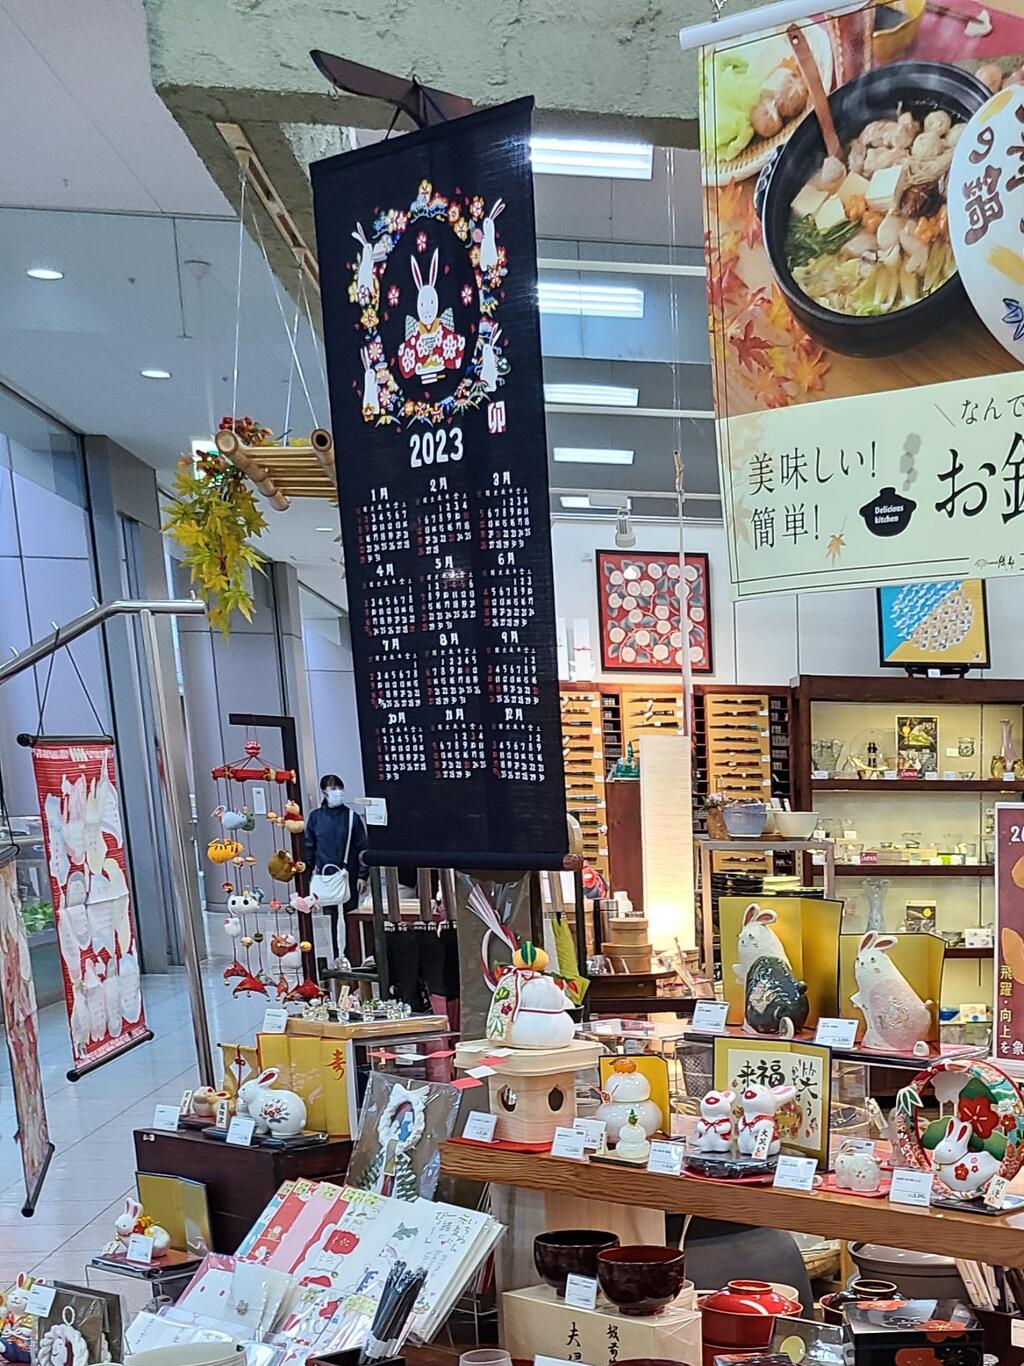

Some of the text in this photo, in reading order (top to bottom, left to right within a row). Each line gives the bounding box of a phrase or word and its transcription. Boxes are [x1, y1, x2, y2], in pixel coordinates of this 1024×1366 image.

[409, 427, 464, 468] 2023
[749, 441, 877, 496] 美味しい！
[430, 477, 448, 492] 2月
[492, 471, 511, 486] 3月
[371, 487, 388, 501] 1月
[874, 504, 904, 515] Delicious
[874, 514, 899, 524] kitchen
[751, 504, 819, 551] 簡単！
[435, 555, 454, 570] 5月
[498, 552, 515, 566] 6月
[376, 563, 394, 577] 4月
[439, 632, 459, 646] 8月
[501, 630, 518, 644] 9月
[382, 638, 400, 651] 7月
[388, 712, 406, 724] 10月
[445, 708, 464, 721] 11月
[505, 708, 523, 721] 12月
[999, 965, 1013, 1038] 飛躍・向上
